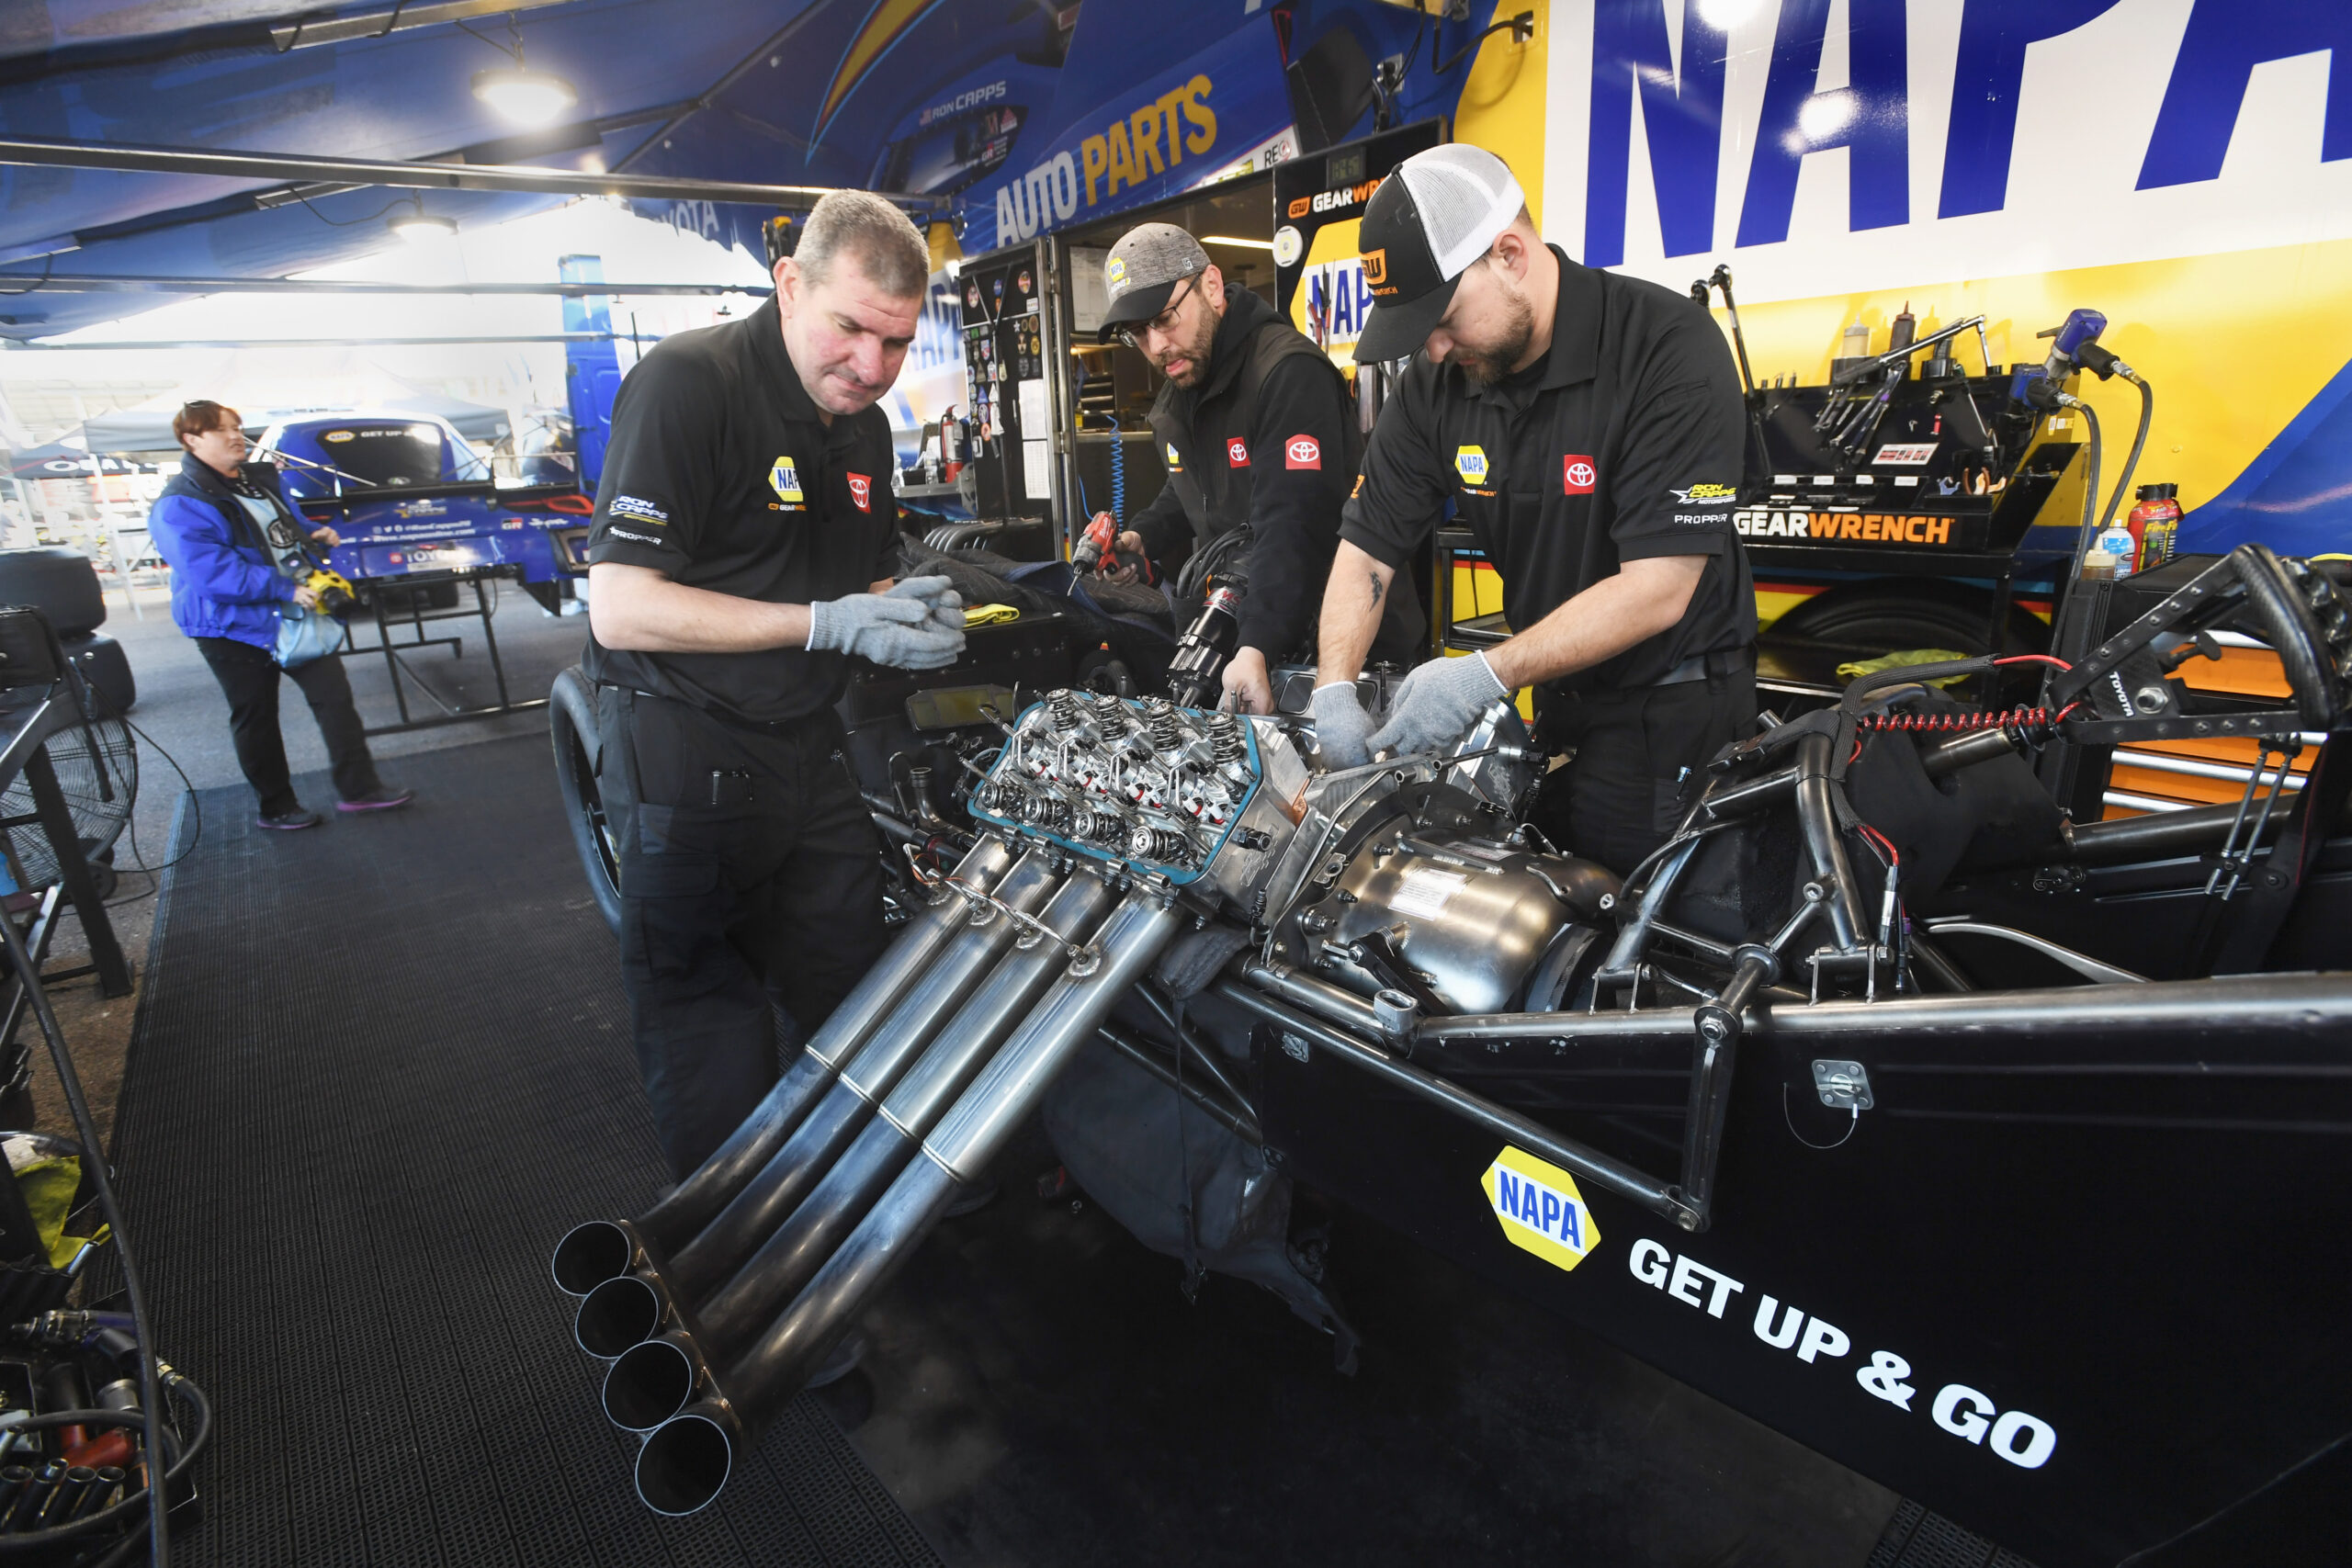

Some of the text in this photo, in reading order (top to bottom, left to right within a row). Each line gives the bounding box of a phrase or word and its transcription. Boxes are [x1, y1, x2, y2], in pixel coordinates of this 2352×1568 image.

[933, 80, 1006, 119] RON CAPPS
[997, 73, 1217, 248] AUTO PARTS
[360, 430, 382, 438] GET
[1460, 455, 1484, 472] NAPA
[1689, 487, 1736, 498] CAPPS
[1691, 483, 1724, 491] RON
[618, 495, 655, 508] RON
[616, 502, 669, 519] CAPPS
[1674, 513, 1728, 525] PROPPER
[1733, 511, 1951, 545] GEARWRENCH
[2109, 671, 2134, 716] TOYOTA
[1499, 1169, 1581, 1248] NAPA
[1629, 1237, 2057, 1469] GET UP & GO
